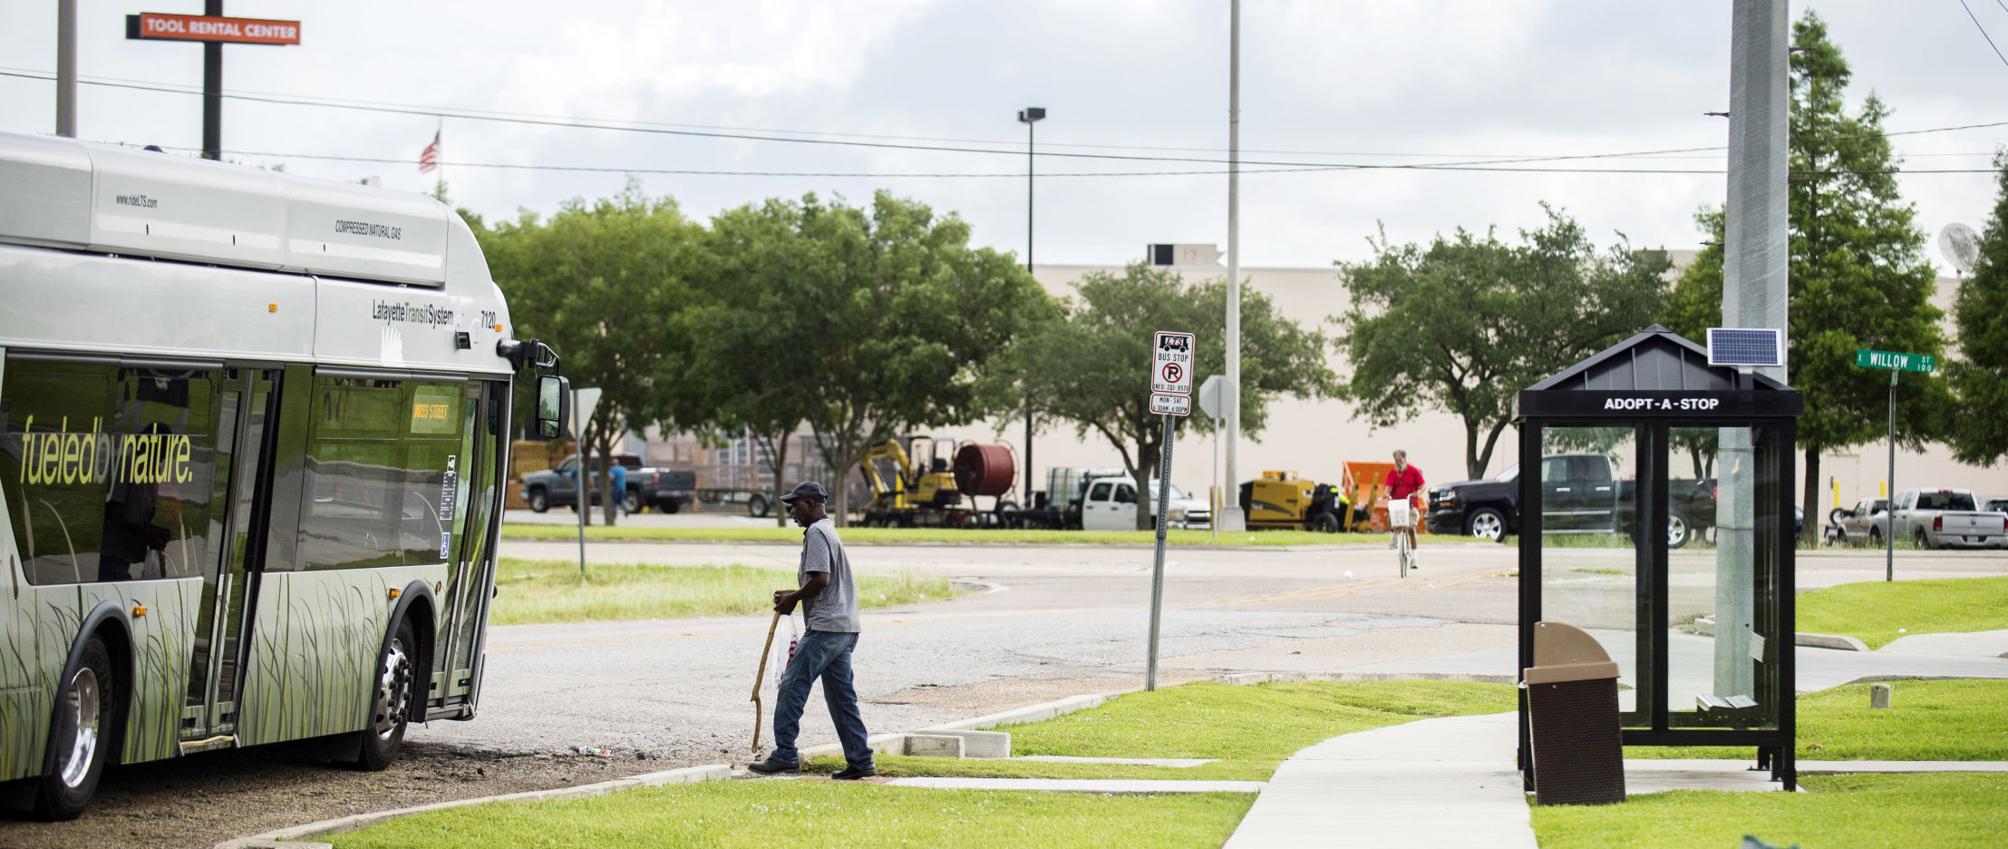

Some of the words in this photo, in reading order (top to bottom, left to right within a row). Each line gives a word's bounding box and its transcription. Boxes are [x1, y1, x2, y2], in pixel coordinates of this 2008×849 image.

[147, 18, 186, 33] TOOL
[189, 20, 242, 36] RENTAL
[244, 24, 298, 39] CENTER
[116, 194, 158, 209] www.rideLTS.com
[335, 219, 369, 236] COMPRESSED
[369, 223, 391, 239] NATURAL
[391, 225, 402, 241] GAS
[372, 299, 454, 329] LafayetteTransitSystem
[481, 310, 496, 329] 7120
[1158, 352, 1171, 361] BUS
[1173, 353, 1189, 362] STOP
[1870, 352, 1909, 368] WILLOW
[1921, 356, 1931, 364] ST
[1917, 363, 1932, 372] 100
[1603, 398, 1720, 410] ADOPT-A-STOP
